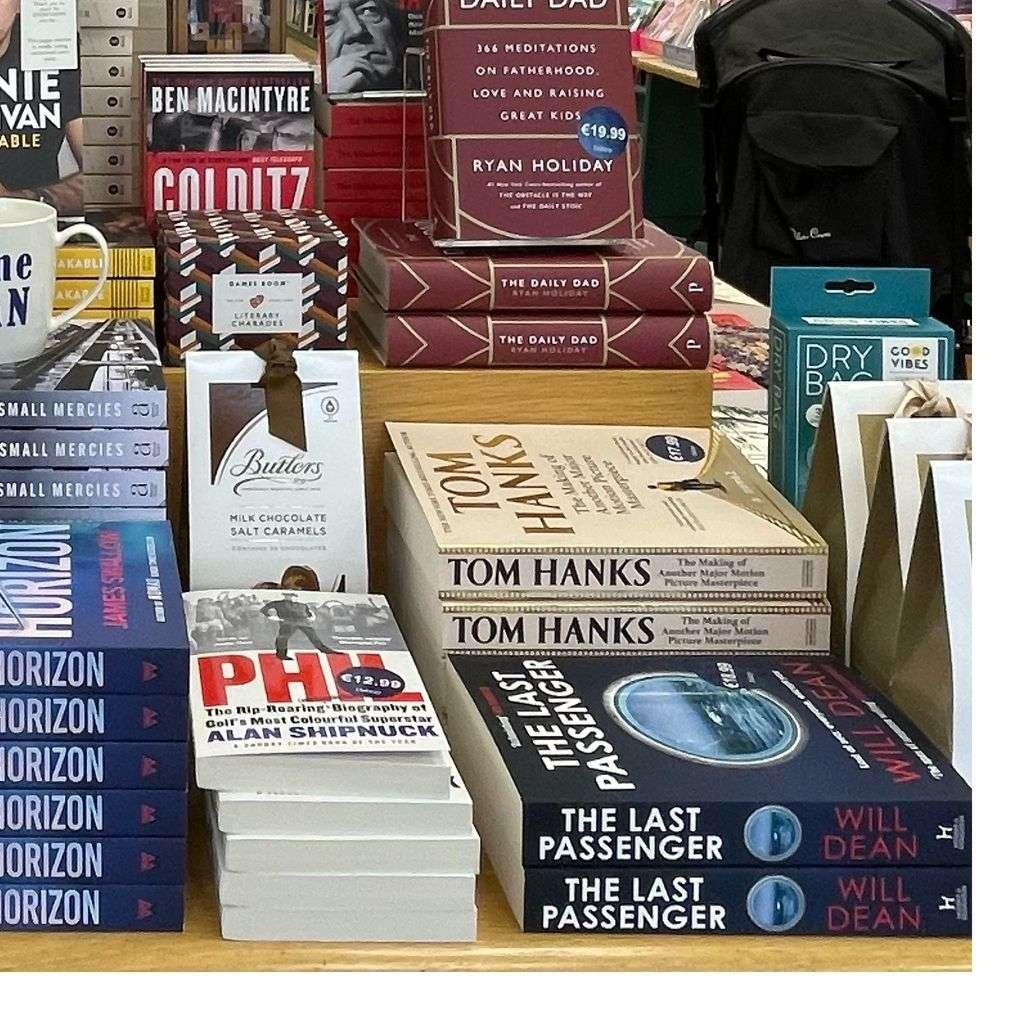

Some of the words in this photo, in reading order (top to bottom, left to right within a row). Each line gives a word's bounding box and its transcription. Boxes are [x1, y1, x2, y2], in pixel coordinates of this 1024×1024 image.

[477, 43, 498, 53] 366
[505, 43, 597, 54] MEDITATIONS
[475, 66, 497, 76] ON
[151, 86, 190, 114] BEN
[197, 85, 311, 114] MACINTYRE
[473, 88, 507, 99] LOVE
[513, 88, 543, 98] AND
[549, 88, 605, 98] RAISING
[500, 111, 544, 121] GREAT
[550, 110, 582, 121] KIDS
[581, 122, 627, 141] €19.99
[473, 159, 523, 173] RYAN
[532, 158, 615, 173] HOLIDAY
[153, 166, 310, 212] COLDITZ
[501, 278, 526, 288] THE
[530, 278, 567, 288] DAILY
[572, 278, 600, 288] DAD
[805, 343, 874, 371] DRY
[890, 358, 929, 369] VIBES
[52, 400, 123, 418] MERCIES
[229, 447, 325, 483] Butlers
[426, 451, 502, 515] TOM
[472, 433, 576, 535] HANKS
[229, 513, 256, 523] MILK
[258, 513, 327, 523] CHOCOLATE
[230, 526, 259, 537] SALT
[263, 526, 327, 537] CARAMELS
[677, 558, 697, 568] The
[699, 557, 735, 569] Making
[738, 556, 747, 567] of
[447, 557, 521, 587] TOM
[533, 557, 652, 587] HANKS
[698, 567, 728, 580] Major
[730, 567, 766, 578] Motion
[663, 578, 700, 589] Picture
[702, 577, 759, 589] Masterpiece
[451, 615, 525, 645] TOM
[537, 615, 655, 645] HANKS
[339, 673, 402, 690] €12.99
[491, 671, 552, 717] LAST
[205, 707, 232, 717] The
[332, 703, 408, 714] Biography
[411, 703, 427, 712] of
[205, 717, 248, 728] Golf's
[250, 716, 287, 726] Most
[290, 715, 358, 725] Colourful
[360, 715, 433, 724] Superstar
[522, 659, 636, 791] PASSENGER
[207, 726, 282, 743] ALAN
[288, 725, 439, 739] SHIPNUCK
[524, 724, 581, 771] THE
[852, 727, 922, 785] WILL
[560, 807, 617, 834] THE
[627, 806, 702, 833] LAST
[834, 806, 909, 834] WILL
[538, 834, 724, 862] PASSENGER
[823, 835, 918, 862] DEAN
